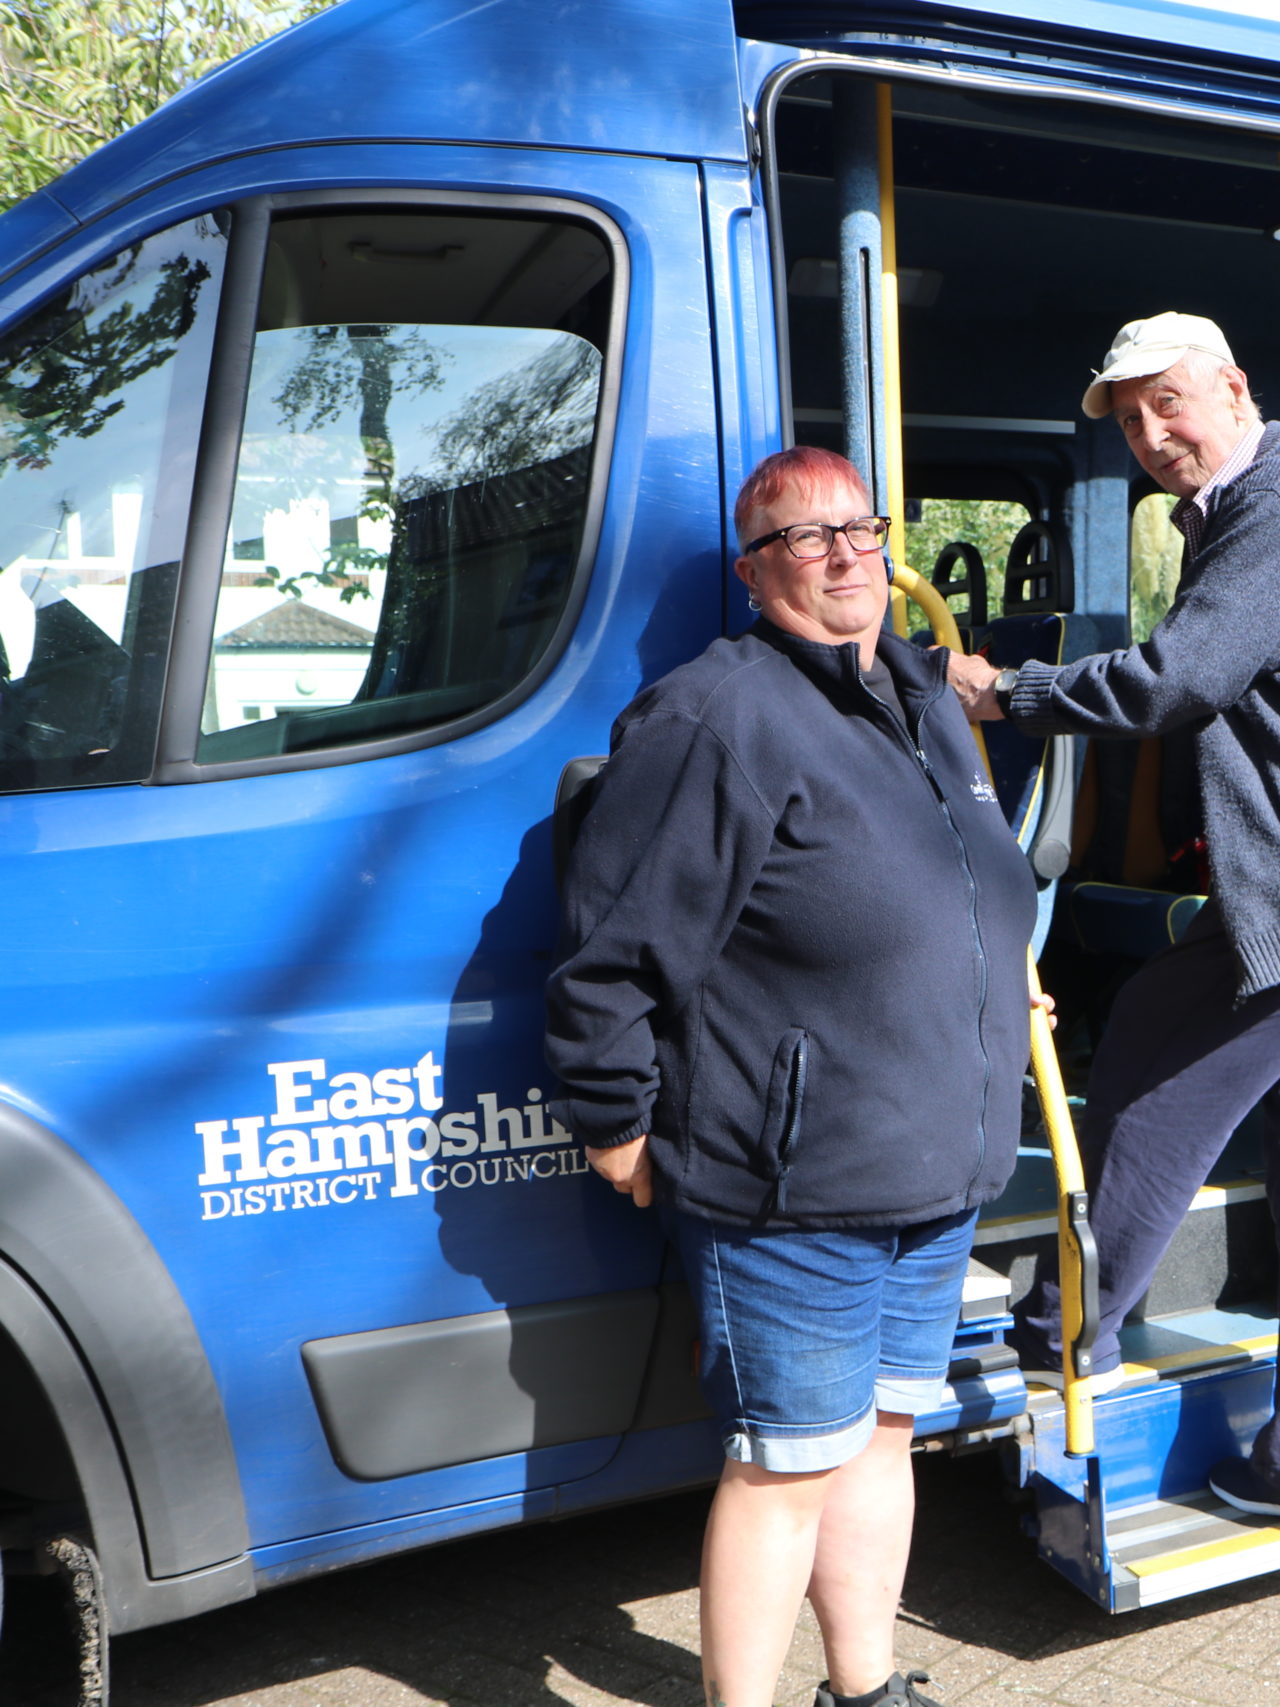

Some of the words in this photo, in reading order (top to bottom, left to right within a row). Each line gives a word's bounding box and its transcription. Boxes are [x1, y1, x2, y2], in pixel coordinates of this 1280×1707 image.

[267, 1050, 444, 1127] East
[201, 1172, 382, 1221] DISTRICT
[421, 1148, 590, 1192] COUNCIL
